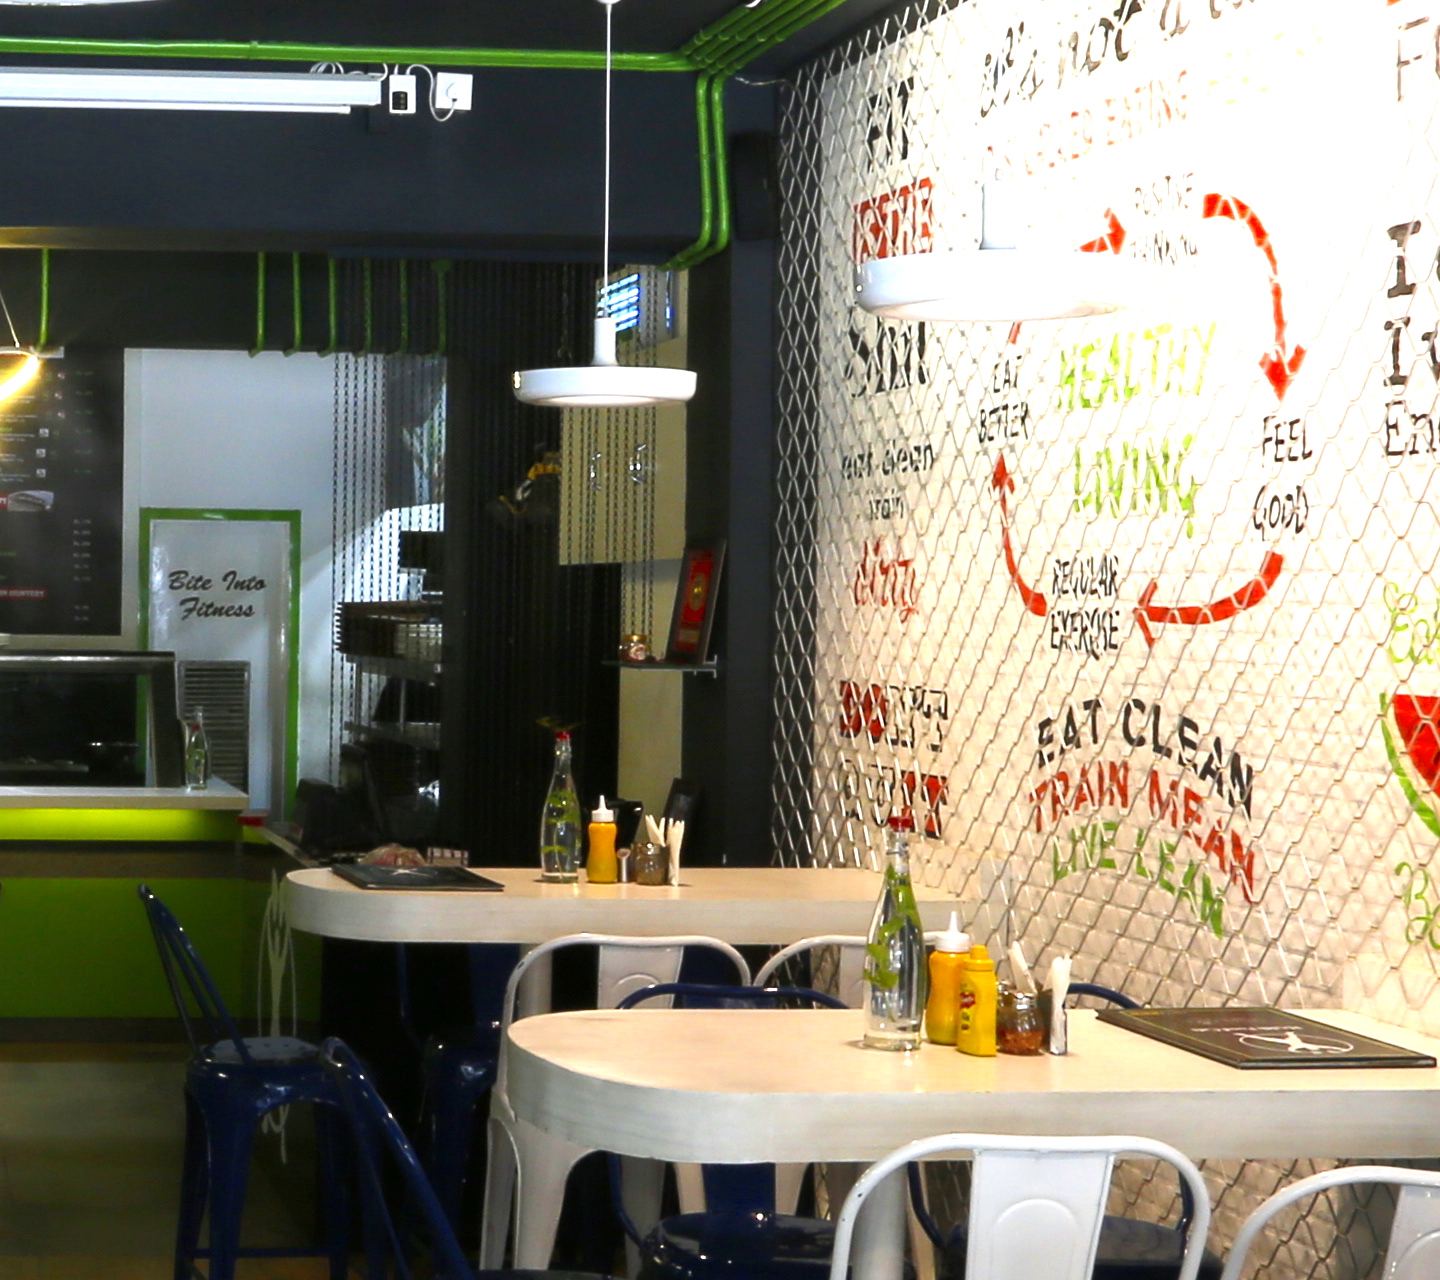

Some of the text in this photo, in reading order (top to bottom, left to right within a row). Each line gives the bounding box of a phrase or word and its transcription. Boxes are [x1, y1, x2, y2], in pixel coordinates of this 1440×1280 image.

[1387, 219, 1422, 298] I
[1057, 320, 1217, 410] HEALTHY
[1384, 316, 1411, 387] I
[978, 402, 1029, 444] BETTER
[1262, 415, 1313, 468] FEEL
[1253, 485, 1310, 541] GOOD
[168, 570, 268, 593] Bite Into
[178, 596, 256, 620] Fitness
[1052, 555, 1120, 600] REGULAR
[1037, 697, 1254, 822] EAT CLEAN
[1028, 759, 1256, 906] TRAIN MEAN
[1052, 820, 1225, 939] LIVE LEAN
